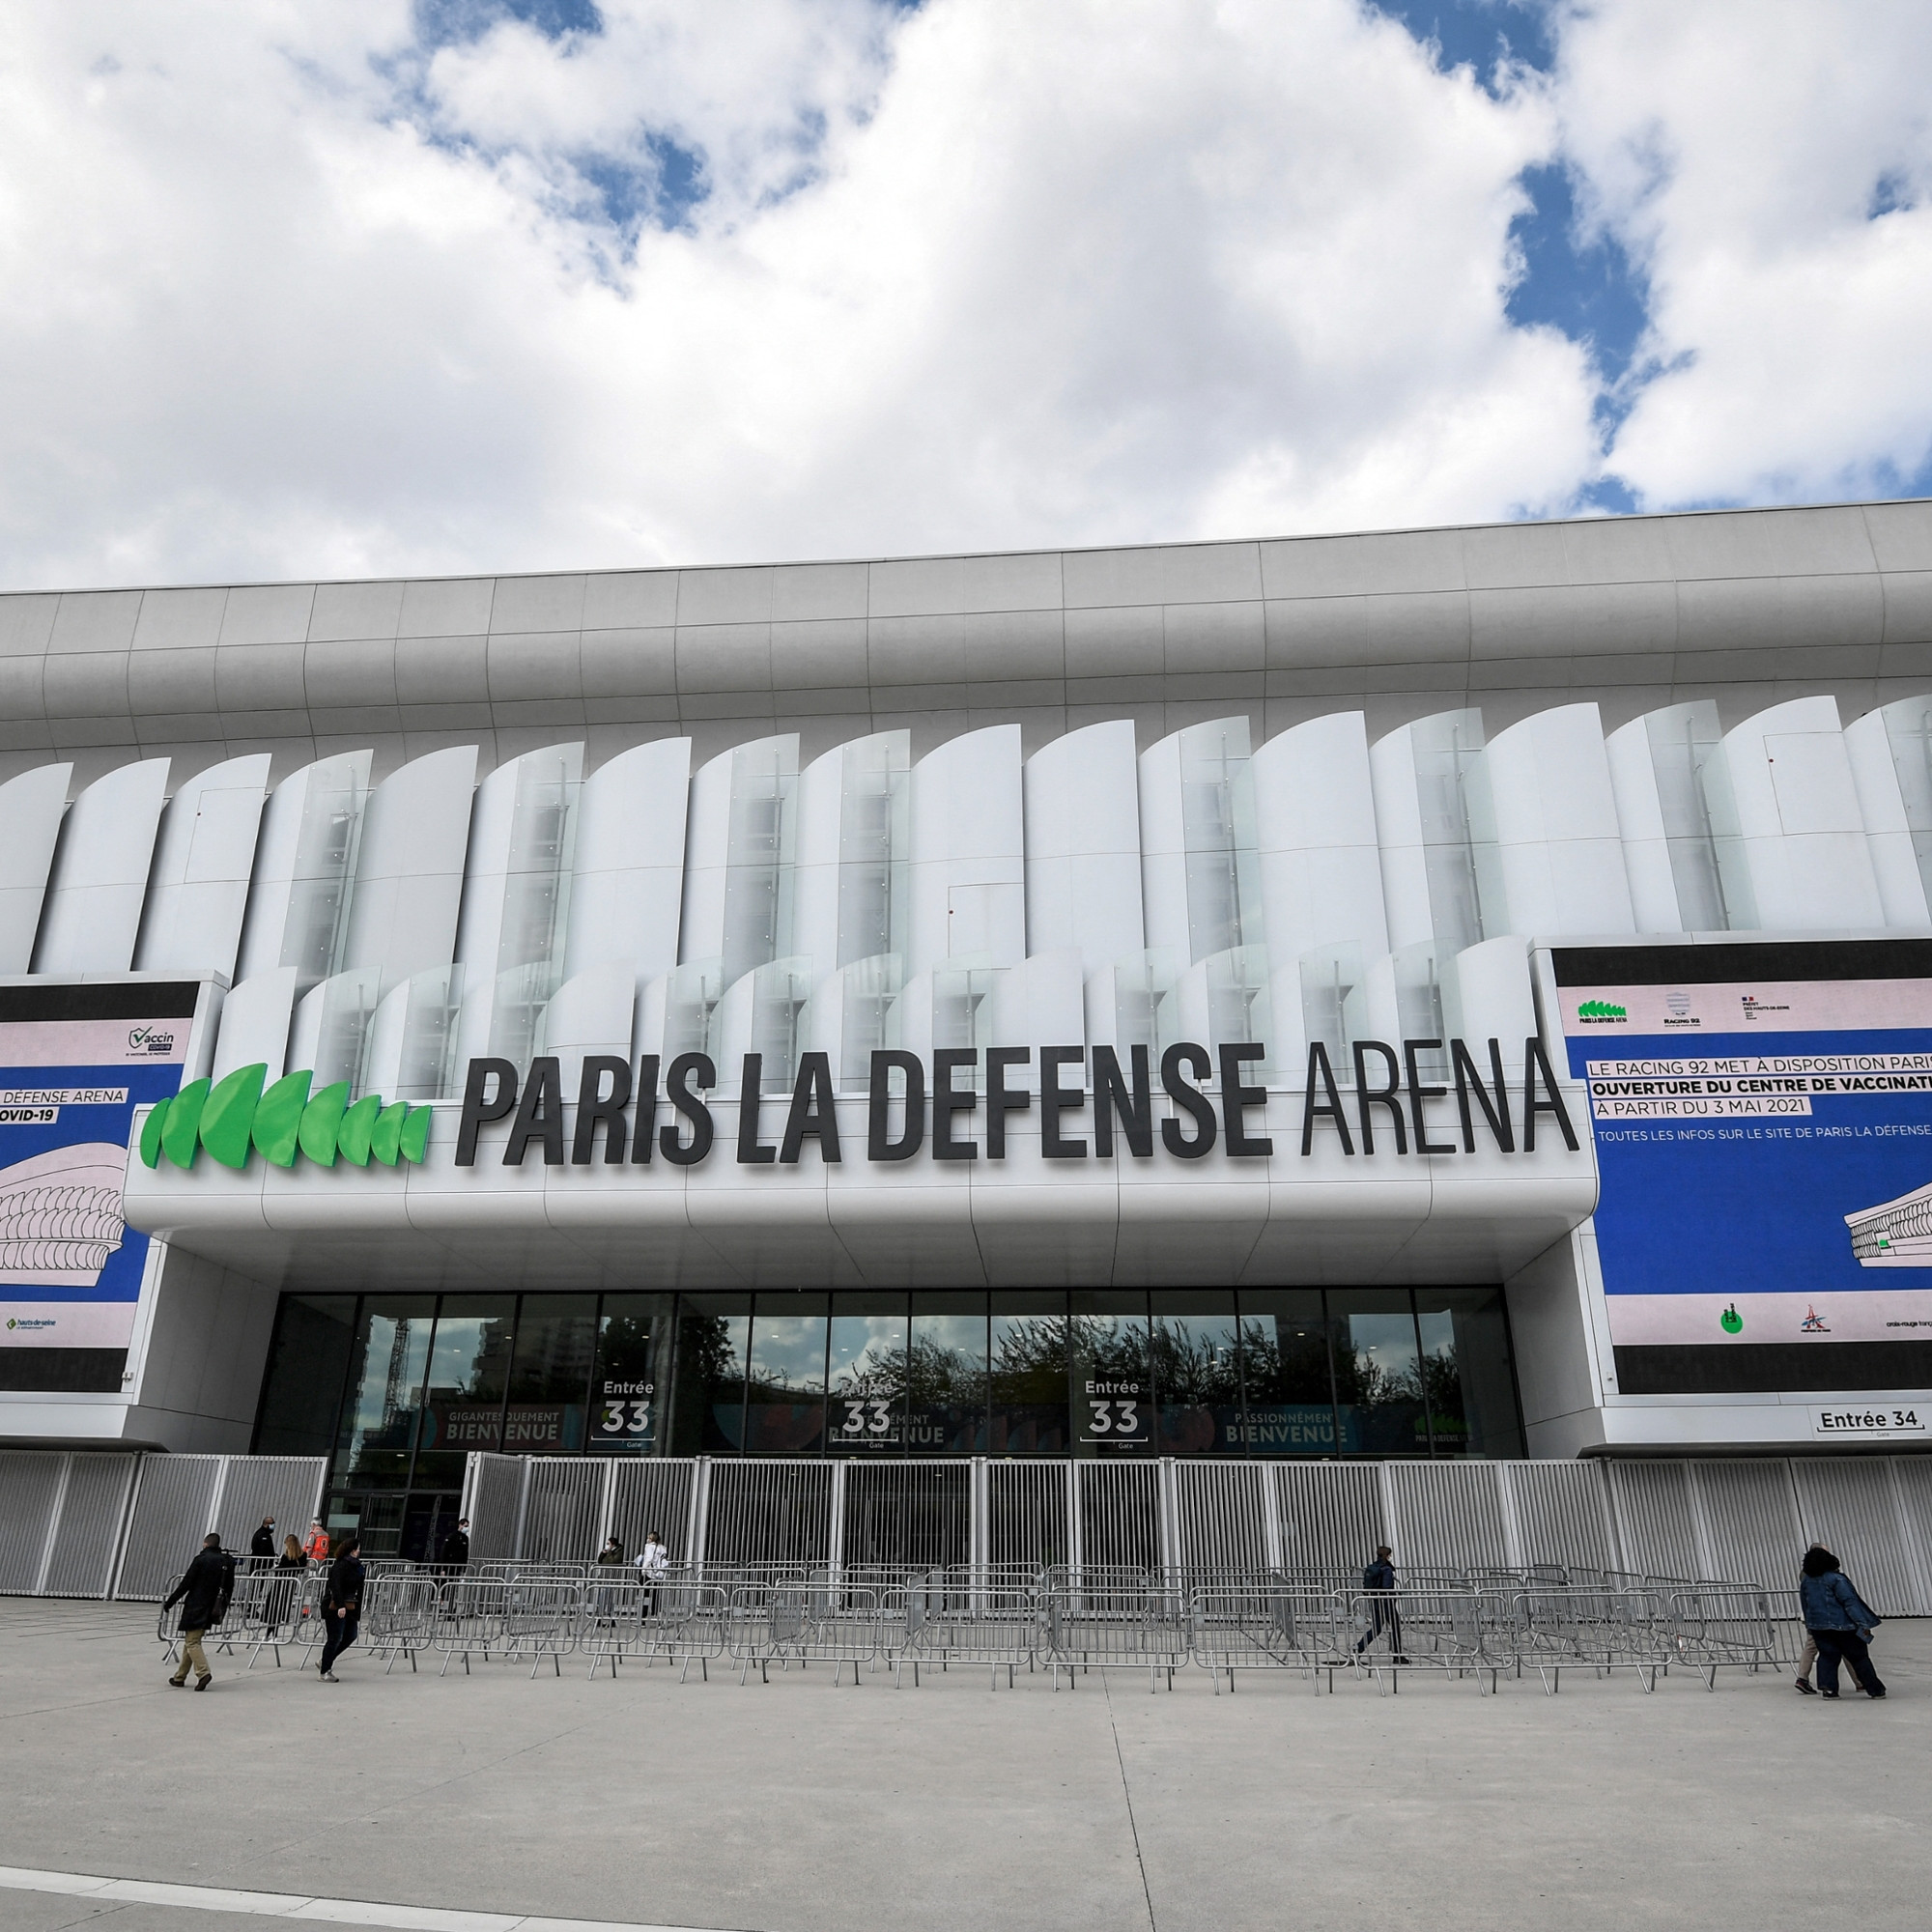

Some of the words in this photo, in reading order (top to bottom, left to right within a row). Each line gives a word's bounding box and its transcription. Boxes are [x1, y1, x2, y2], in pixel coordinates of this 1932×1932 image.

[1589, 1063, 1611, 1076] LE
[1615, 1061, 1685, 1075] RACING
[1689, 1060, 1710, 1074] 92
[1714, 1060, 1749, 1074] MET
[1756, 1056, 1770, 1072] À
[1774, 1056, 1886, 1072] DISPOSITION
[1592, 1080, 1703, 1096] OUVERTURE
[1707, 1079, 1733, 1094] DU
[1736, 1079, 1808, 1094] CENTRE
[1811, 1077, 1837, 1092] DE
[3, 1090, 70, 1103] DÉFENSE
[72, 1090, 125, 1102] ARENA
[455, 1051, 717, 1167] PARIS
[736, 1051, 842, 1164] LA
[868, 1041, 1274, 1162] DEFENSE
[1301, 1037, 1580, 1157] ARENA
[1596, 1099, 1609, 1116] À
[1613, 1100, 1678, 1116] PARTIR
[1682, 1100, 1709, 1115] DU
[1714, 1100, 1724, 1114] 3
[1728, 1099, 1762, 1114] MAI
[1766, 1098, 1805, 1113] 2021
[1598, 1130, 1649, 1142] TOUTES
[1651, 1129, 1675, 1141] LES
[1677, 1129, 1716, 1141] INFOS
[1718, 1128, 1745, 1140] SUR
[1747, 1128, 1763, 1140] LE
[1765, 1127, 1793, 1139] SITE
[1795, 1126, 1813, 1138] DE
[1815, 1126, 1853, 1138] PARIS
[1855, 1125, 1873, 1137] LA
[1874, 1122, 1932, 1137] DÉFENSE
[603, 1379, 655, 1395] Entrée
[1085, 1379, 1140, 1395] Entrée
[601, 1400, 650, 1433] 33
[842, 1400, 891, 1433] 33
[1088, 1400, 1139, 1434] 33
[1820, 1409, 1888, 1428] Entrée
[1891, 1409, 1918, 1427] 34
